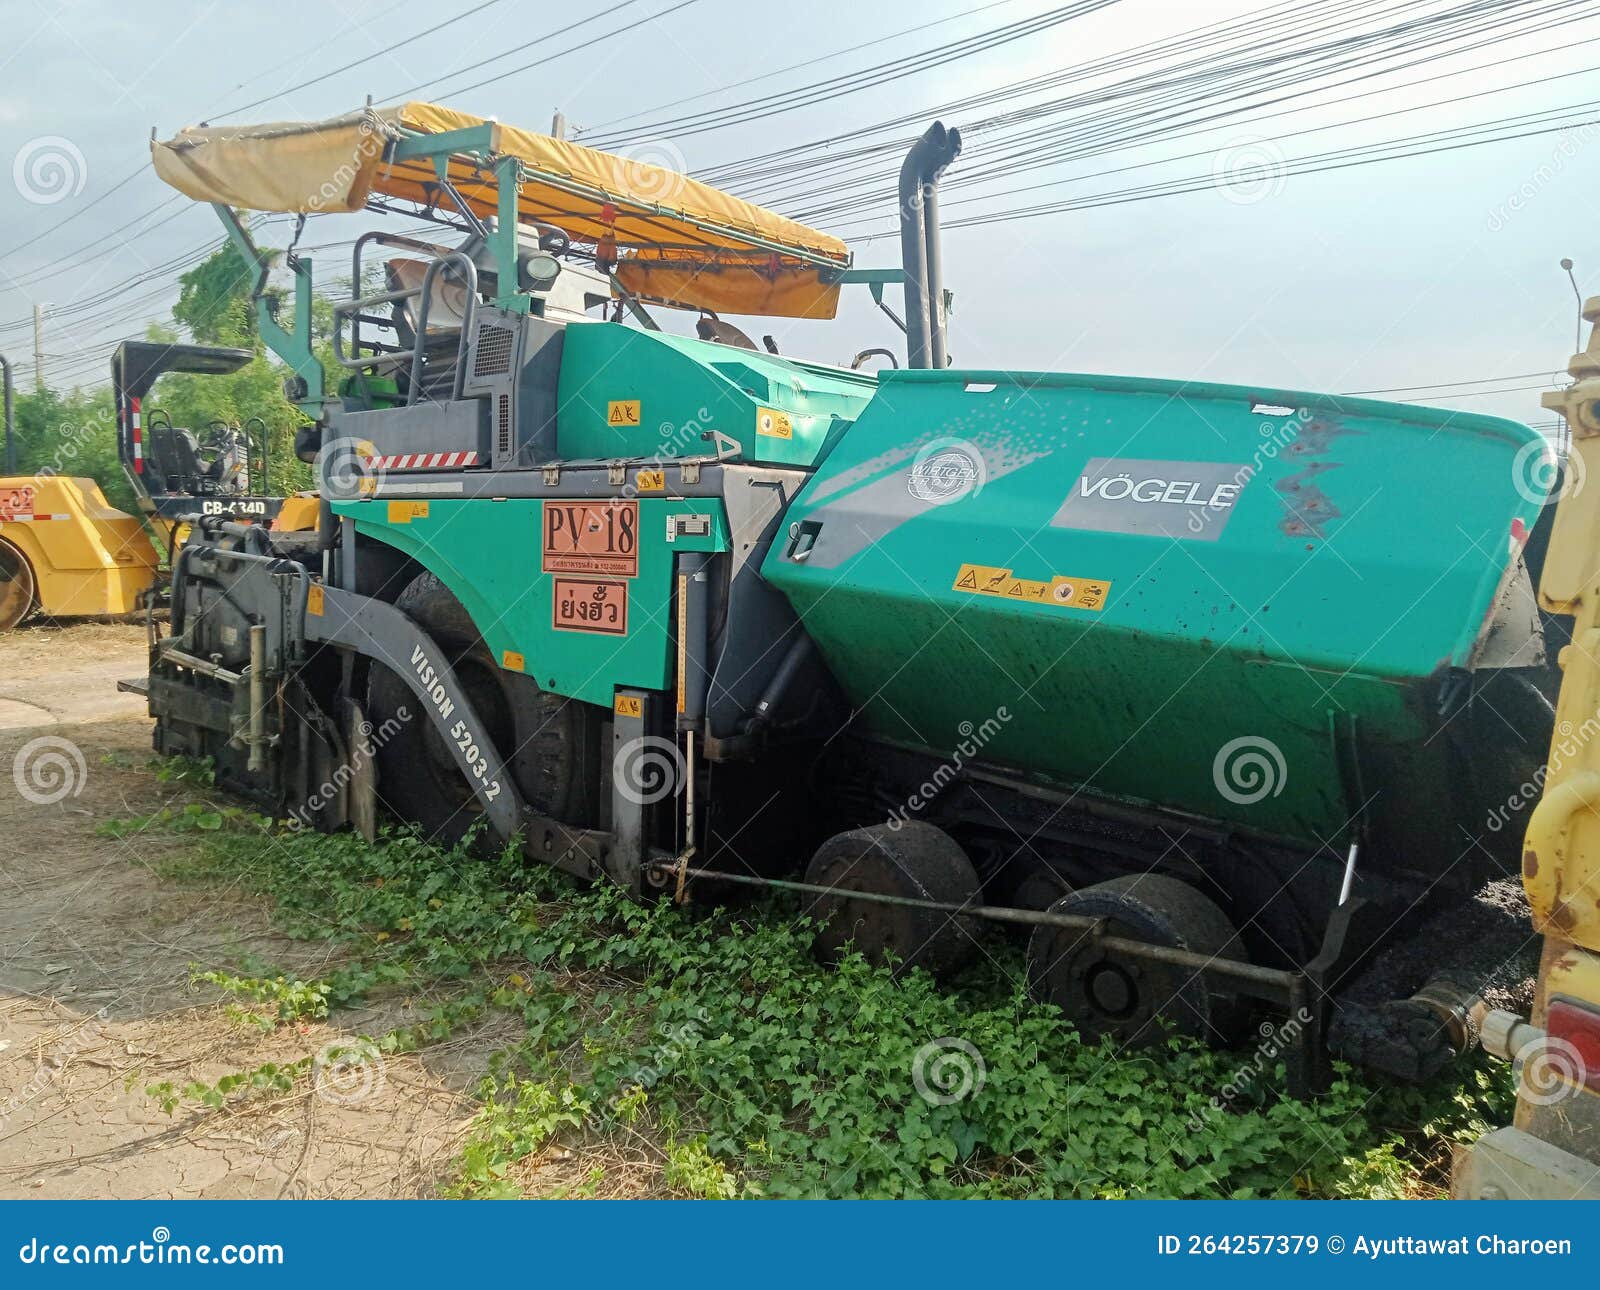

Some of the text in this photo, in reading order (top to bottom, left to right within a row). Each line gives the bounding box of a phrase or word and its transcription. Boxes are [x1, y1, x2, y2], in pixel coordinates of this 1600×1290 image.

[912, 464, 979, 481] WIRTGEN
[1080, 473, 1241, 507] VÖGELE
[410, 644, 501, 802] VISION 5203-2
